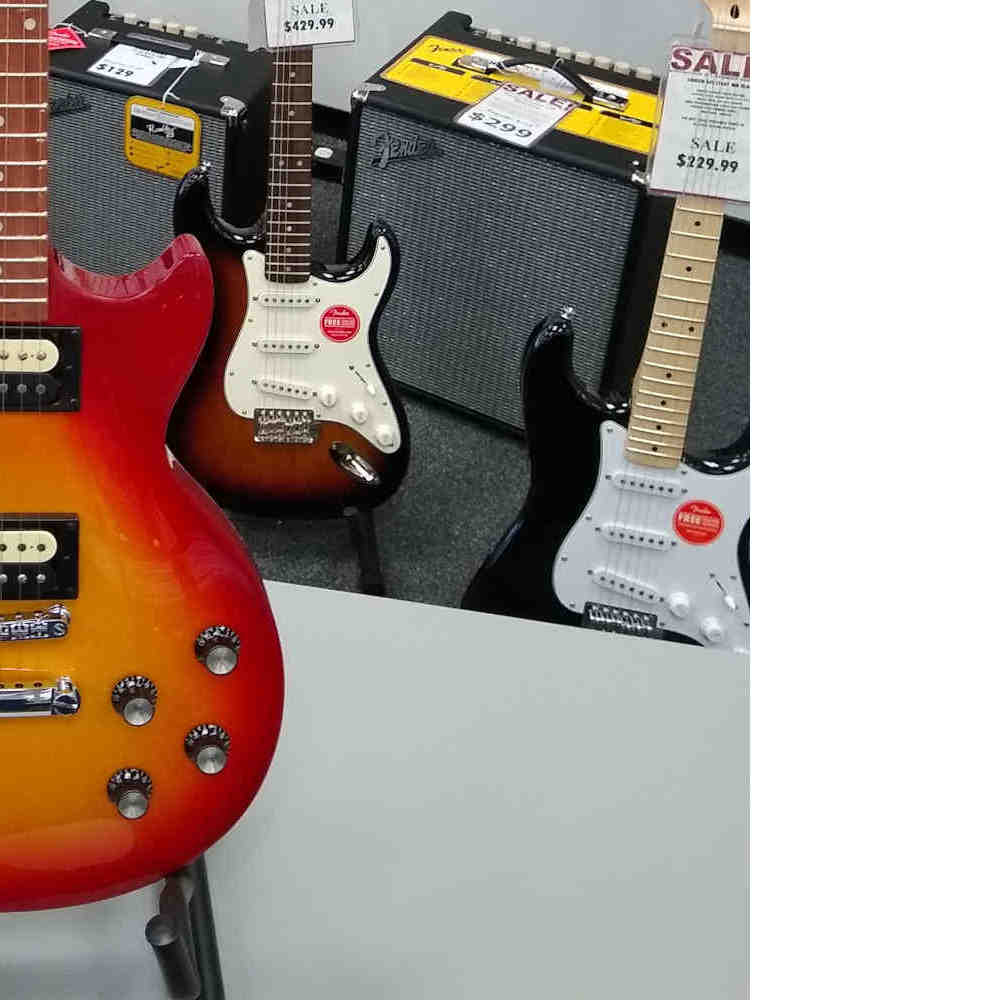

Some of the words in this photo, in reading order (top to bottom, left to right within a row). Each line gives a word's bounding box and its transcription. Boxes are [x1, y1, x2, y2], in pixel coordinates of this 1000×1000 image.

[291, 2, 329, 15] SALE
[284, 18, 335, 32] $429.99
[96, 63, 134, 78] $129
[502, 82, 576, 111] SALE!
[470, 111, 532, 138] $299
[690, 136, 736, 154] SALE
[676, 153, 739, 173] $229.99
